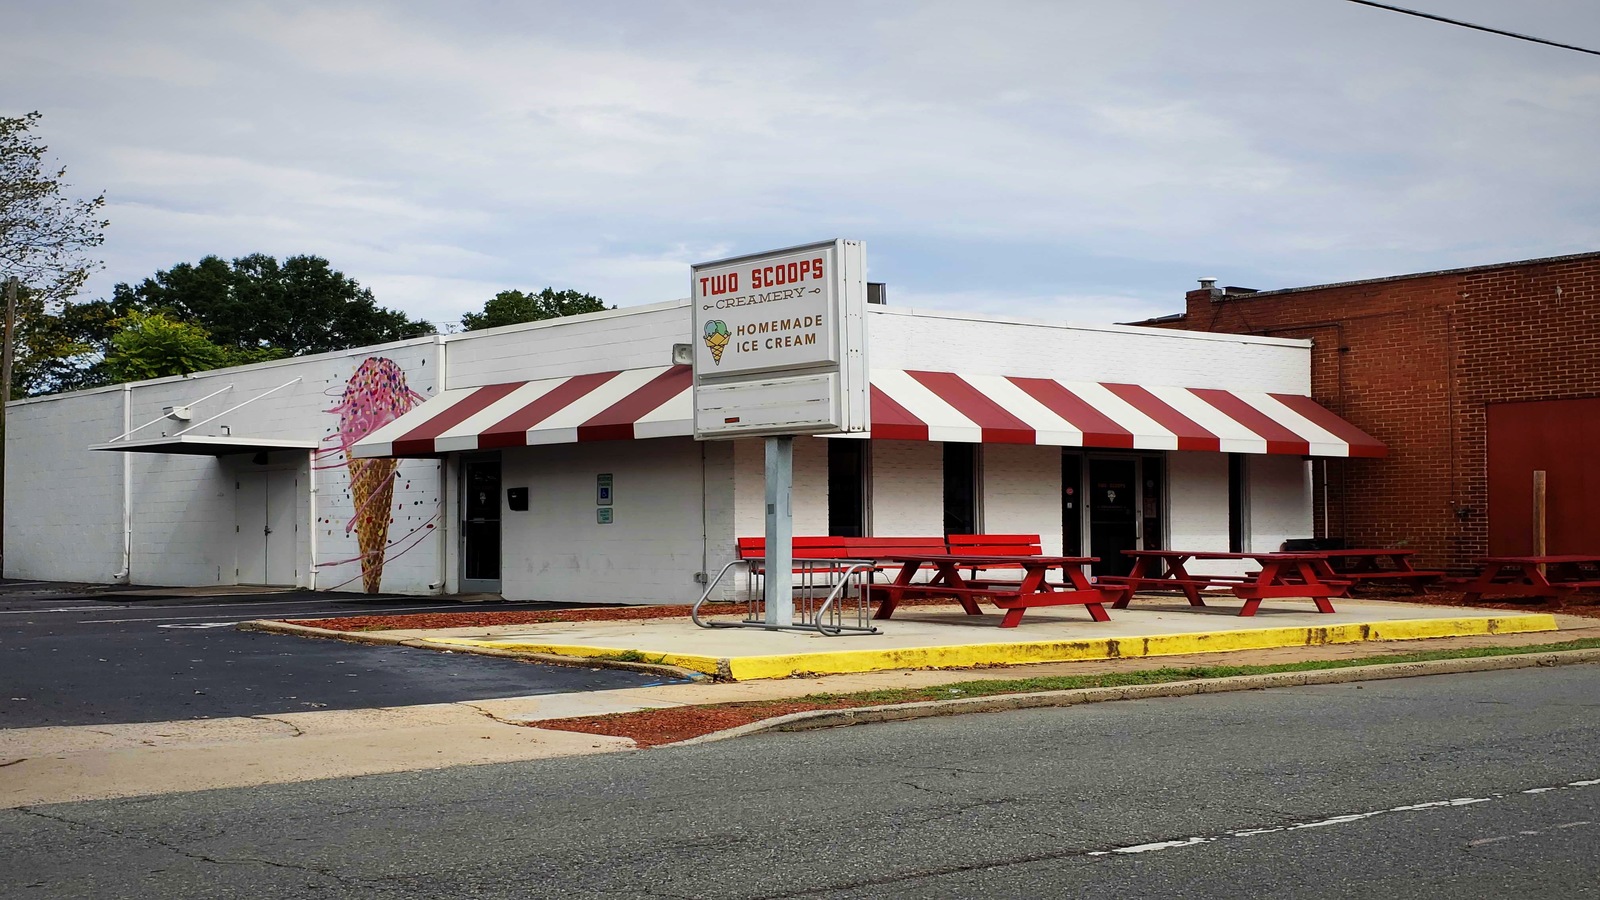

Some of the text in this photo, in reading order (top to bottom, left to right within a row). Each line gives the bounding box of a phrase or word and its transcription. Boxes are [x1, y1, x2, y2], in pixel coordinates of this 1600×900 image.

[700, 258, 823, 297] TWO SCOOPS
[715, 287, 806, 310] CREAMERY
[736, 315, 822, 337] HOMEMADE
[736, 333, 816, 353] ICE CREAM
